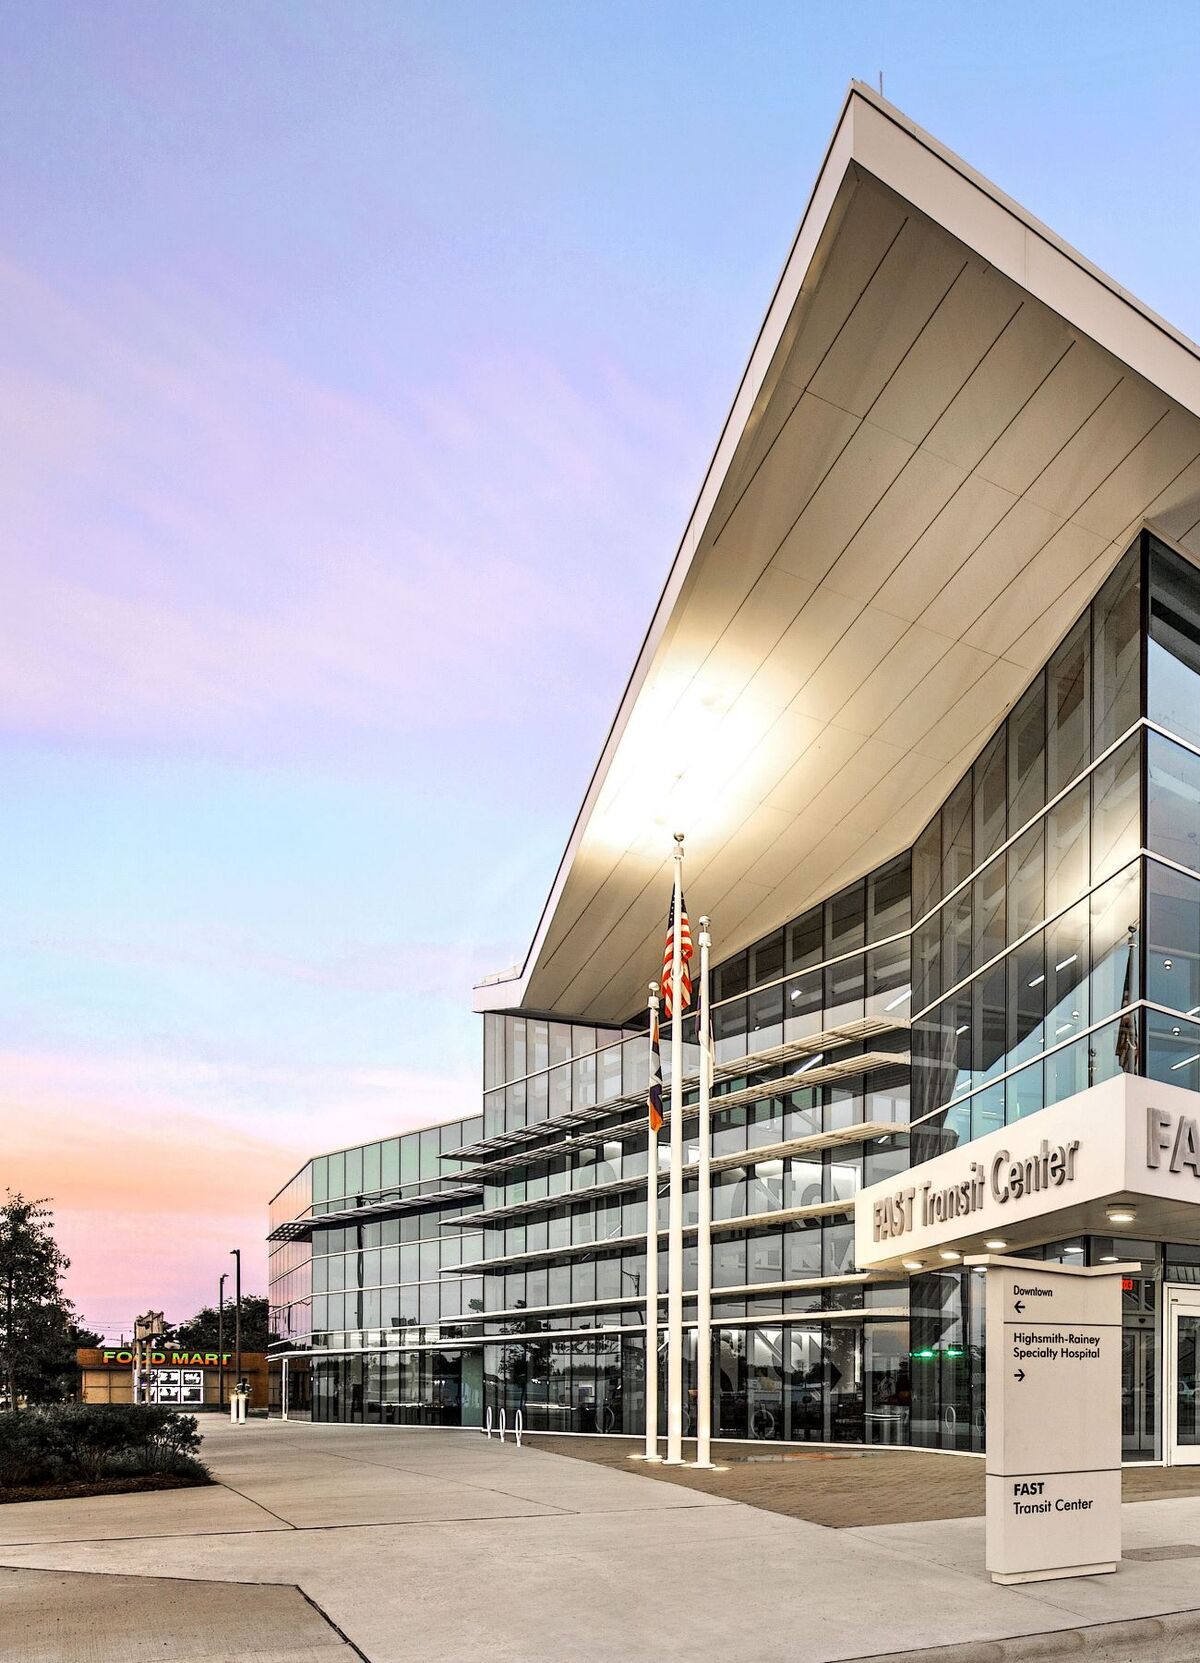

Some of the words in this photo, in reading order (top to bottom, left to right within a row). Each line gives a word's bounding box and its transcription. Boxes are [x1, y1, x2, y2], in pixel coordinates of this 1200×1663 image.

[873, 1187, 915, 1242] FAST
[919, 1162, 985, 1226] Transit
[990, 1139, 1080, 1203] Center
[1013, 1285, 1053, 1297] Downtown
[1013, 1332, 1100, 1346] Highsmith-Rainey
[171, 1353, 232, 1366] MART
[1013, 1347, 1058, 1360] Specialty
[1061, 1348, 1100, 1360] Hospital
[1014, 1482, 1045, 1496] FAST
[1013, 1500, 1052, 1515] Transit
[1055, 1499, 1093, 1511] Center
